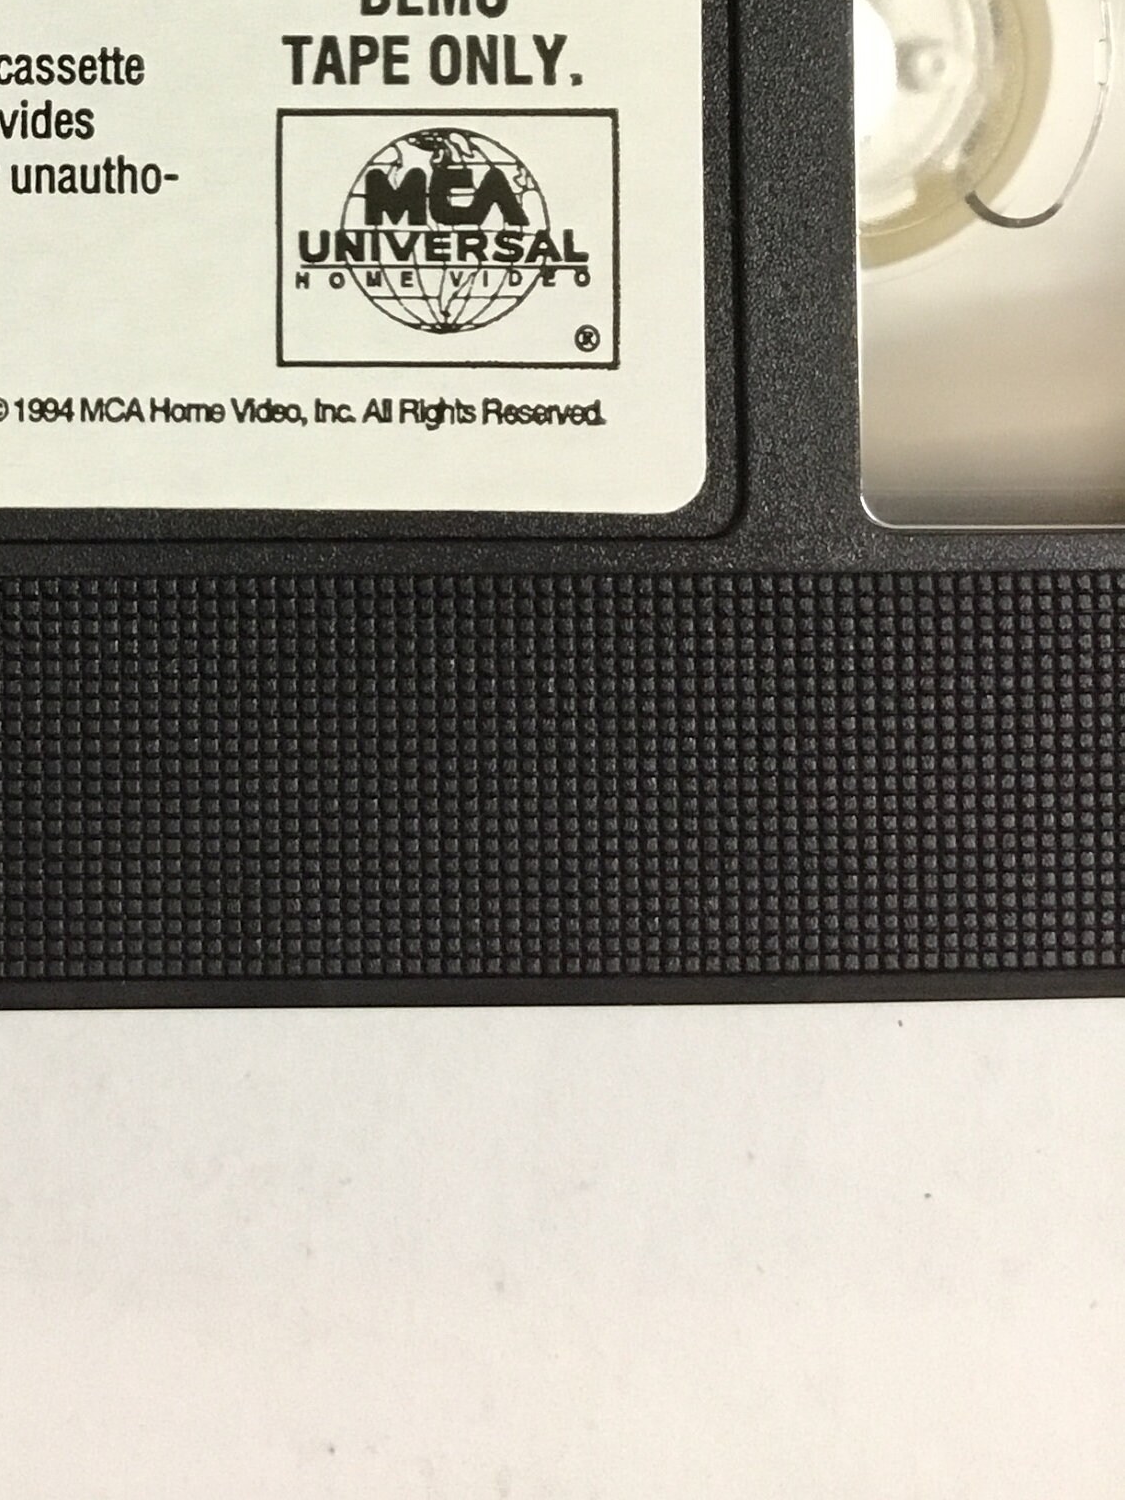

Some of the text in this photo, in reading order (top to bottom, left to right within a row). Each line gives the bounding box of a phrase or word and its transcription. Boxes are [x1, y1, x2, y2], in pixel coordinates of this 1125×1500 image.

[282, 34, 583, 87] TAPE ONLY.
[10, 155, 179, 195] unautho-
[364, 166, 530, 227] MCA
[297, 228, 590, 263] UNIVERSAL
[295, 269, 592, 289] HOME VIDEO
[80, 397, 145, 423] MCA
[150, 397, 226, 423] Home
[230, 397, 308, 427] Video,
[315, 397, 357, 424] Inc.
[362, 398, 393, 424] All
[399, 397, 477, 431] Rights
[482, 397, 607, 426] Reserved.
